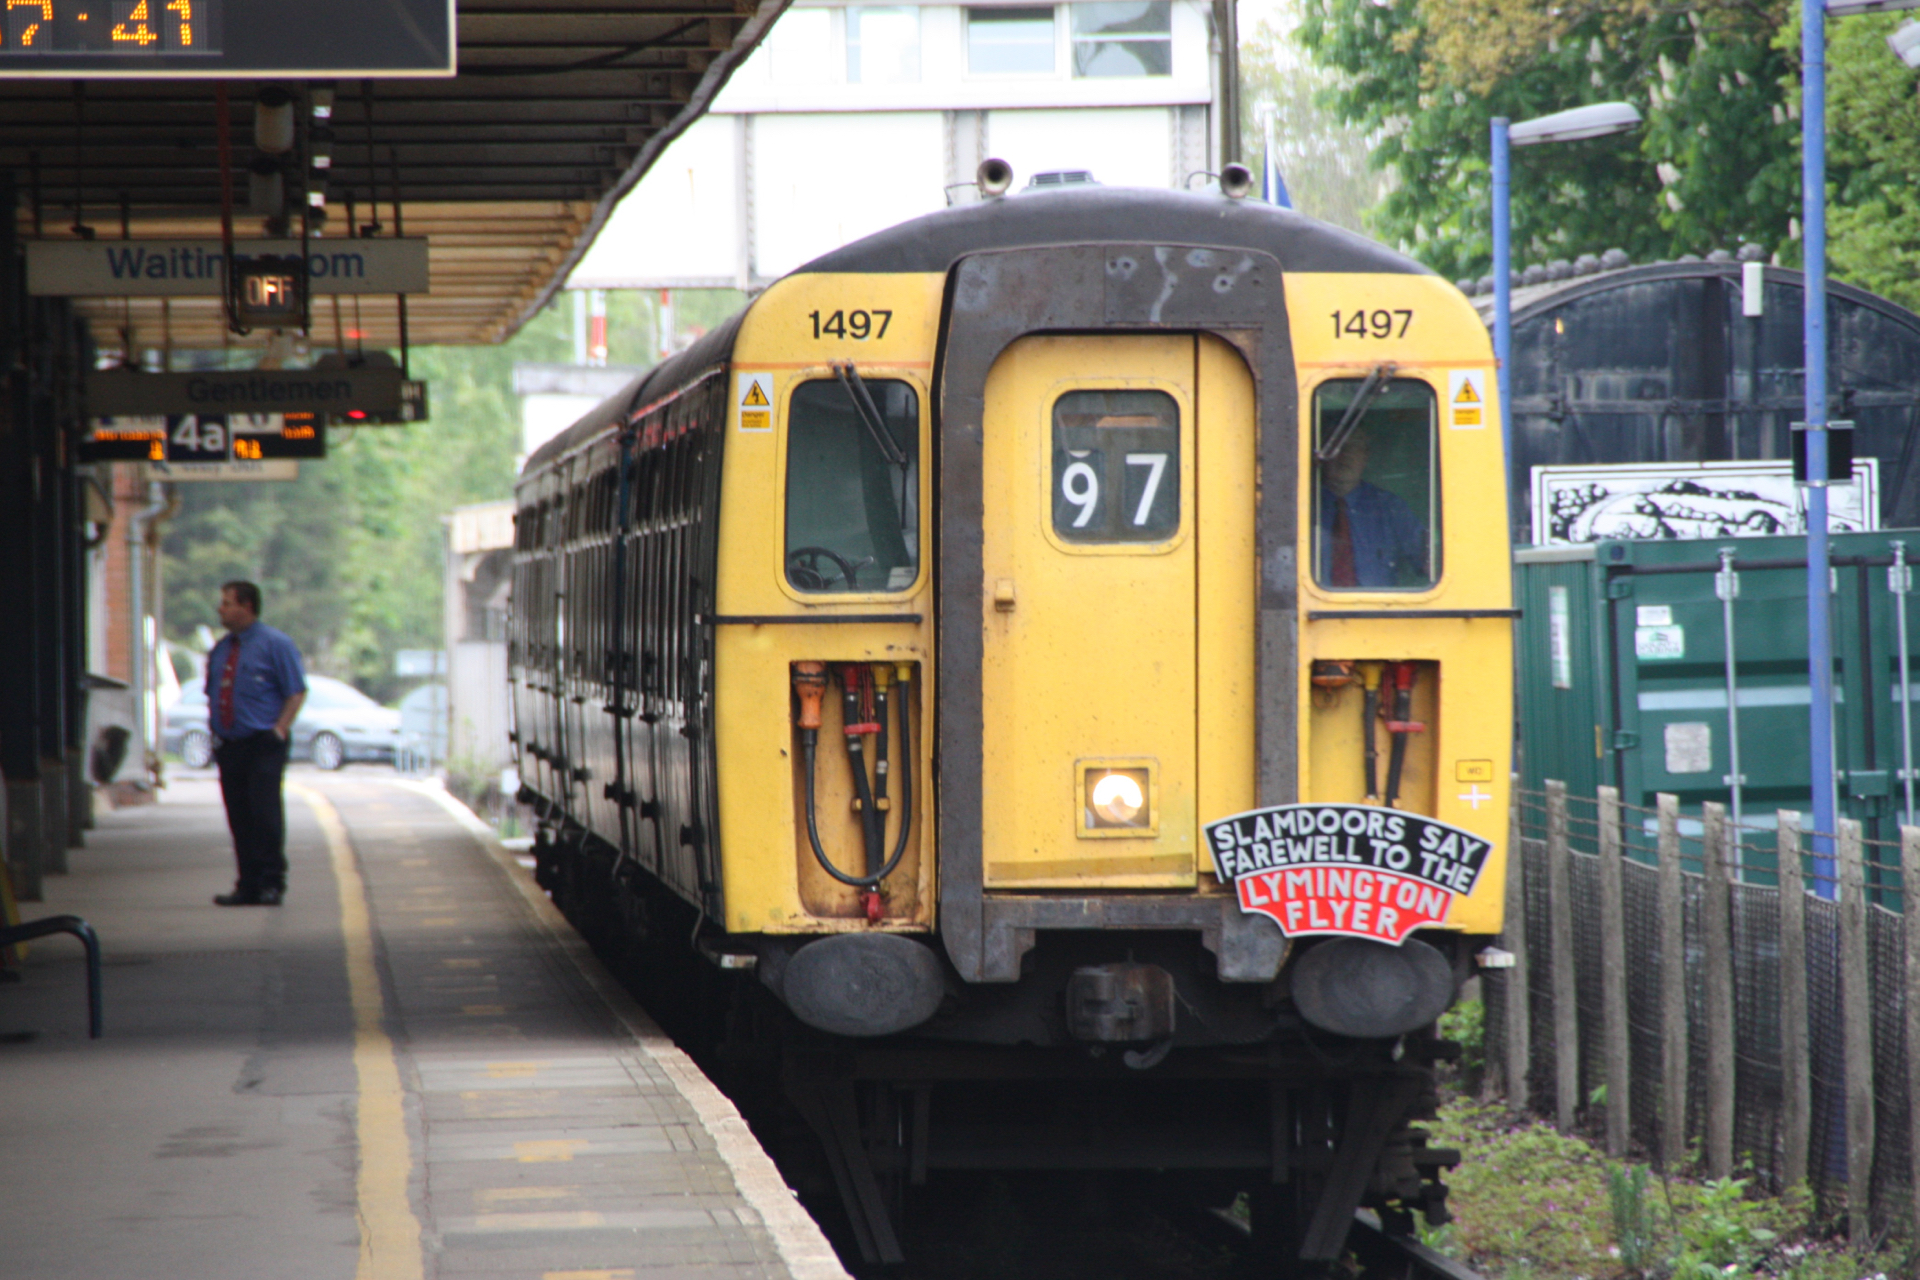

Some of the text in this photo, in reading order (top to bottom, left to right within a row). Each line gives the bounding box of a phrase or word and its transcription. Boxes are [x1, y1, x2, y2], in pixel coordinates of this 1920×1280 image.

[808, 309, 893, 340] 1497
[1330, 308, 1414, 340] 1497
[186, 378, 353, 402] Gentlemen
[172, 413, 226, 452] 4a
[1214, 808, 1482, 864] SLAMDOORS SAY
[1218, 835, 1475, 893] FAREWELL TO THE
[1245, 868, 1445, 919] LYMINGTON
[1285, 899, 1399, 938] FLYER
